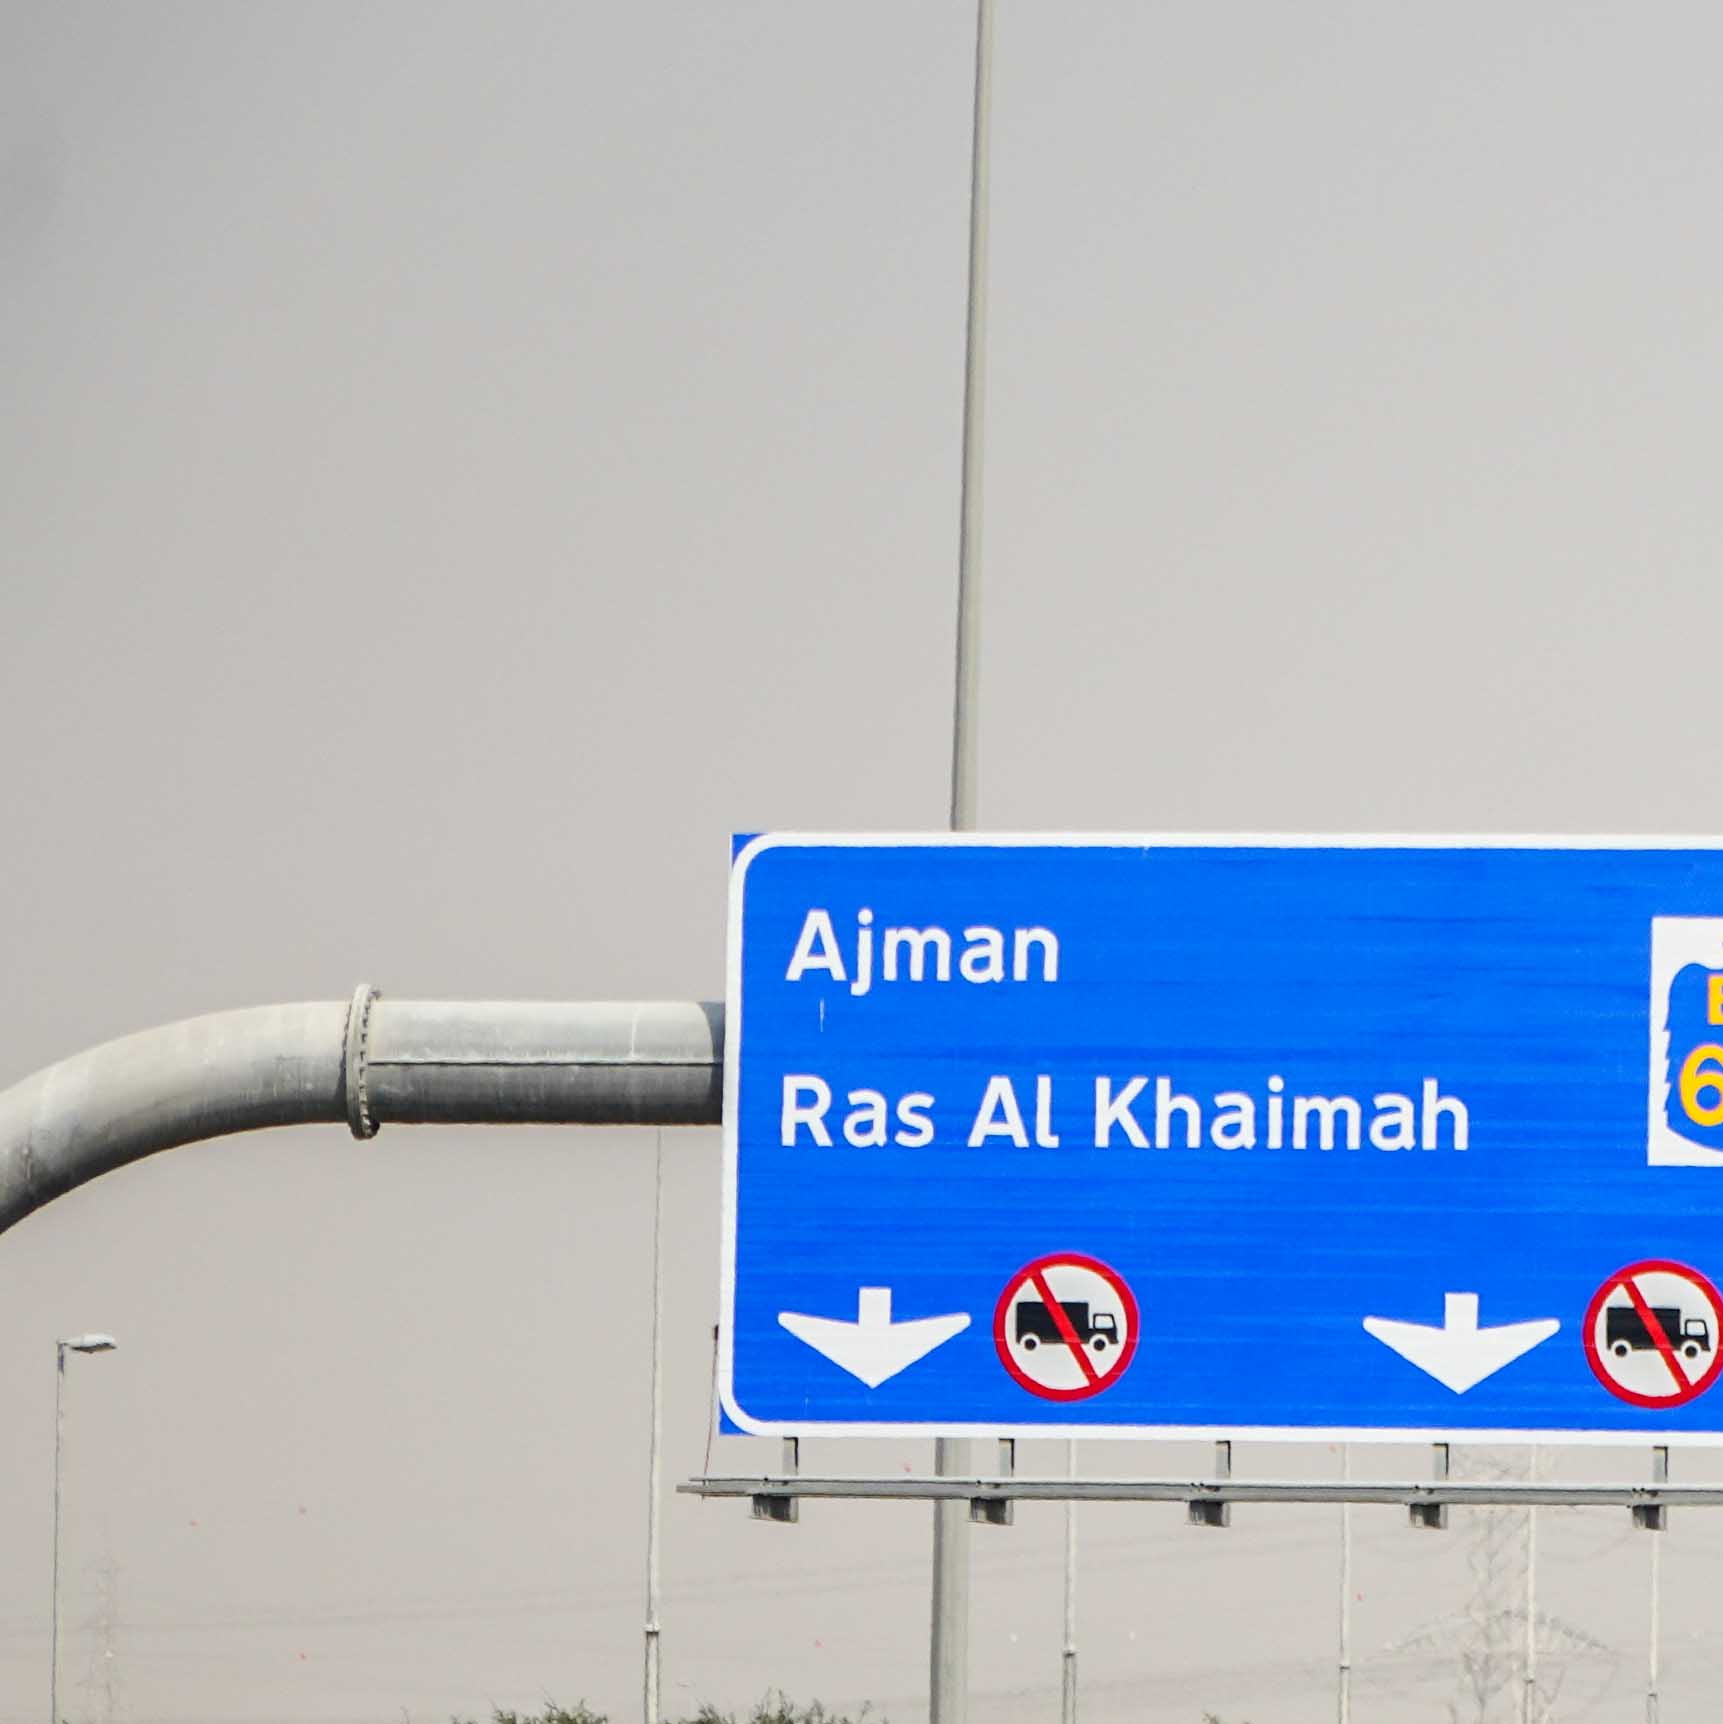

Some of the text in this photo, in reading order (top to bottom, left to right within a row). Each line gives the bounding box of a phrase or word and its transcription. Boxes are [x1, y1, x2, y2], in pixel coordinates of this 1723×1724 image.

[783, 906, 1061, 998] Ajman
[779, 1072, 1471, 1153] Ras Al Khaimah
